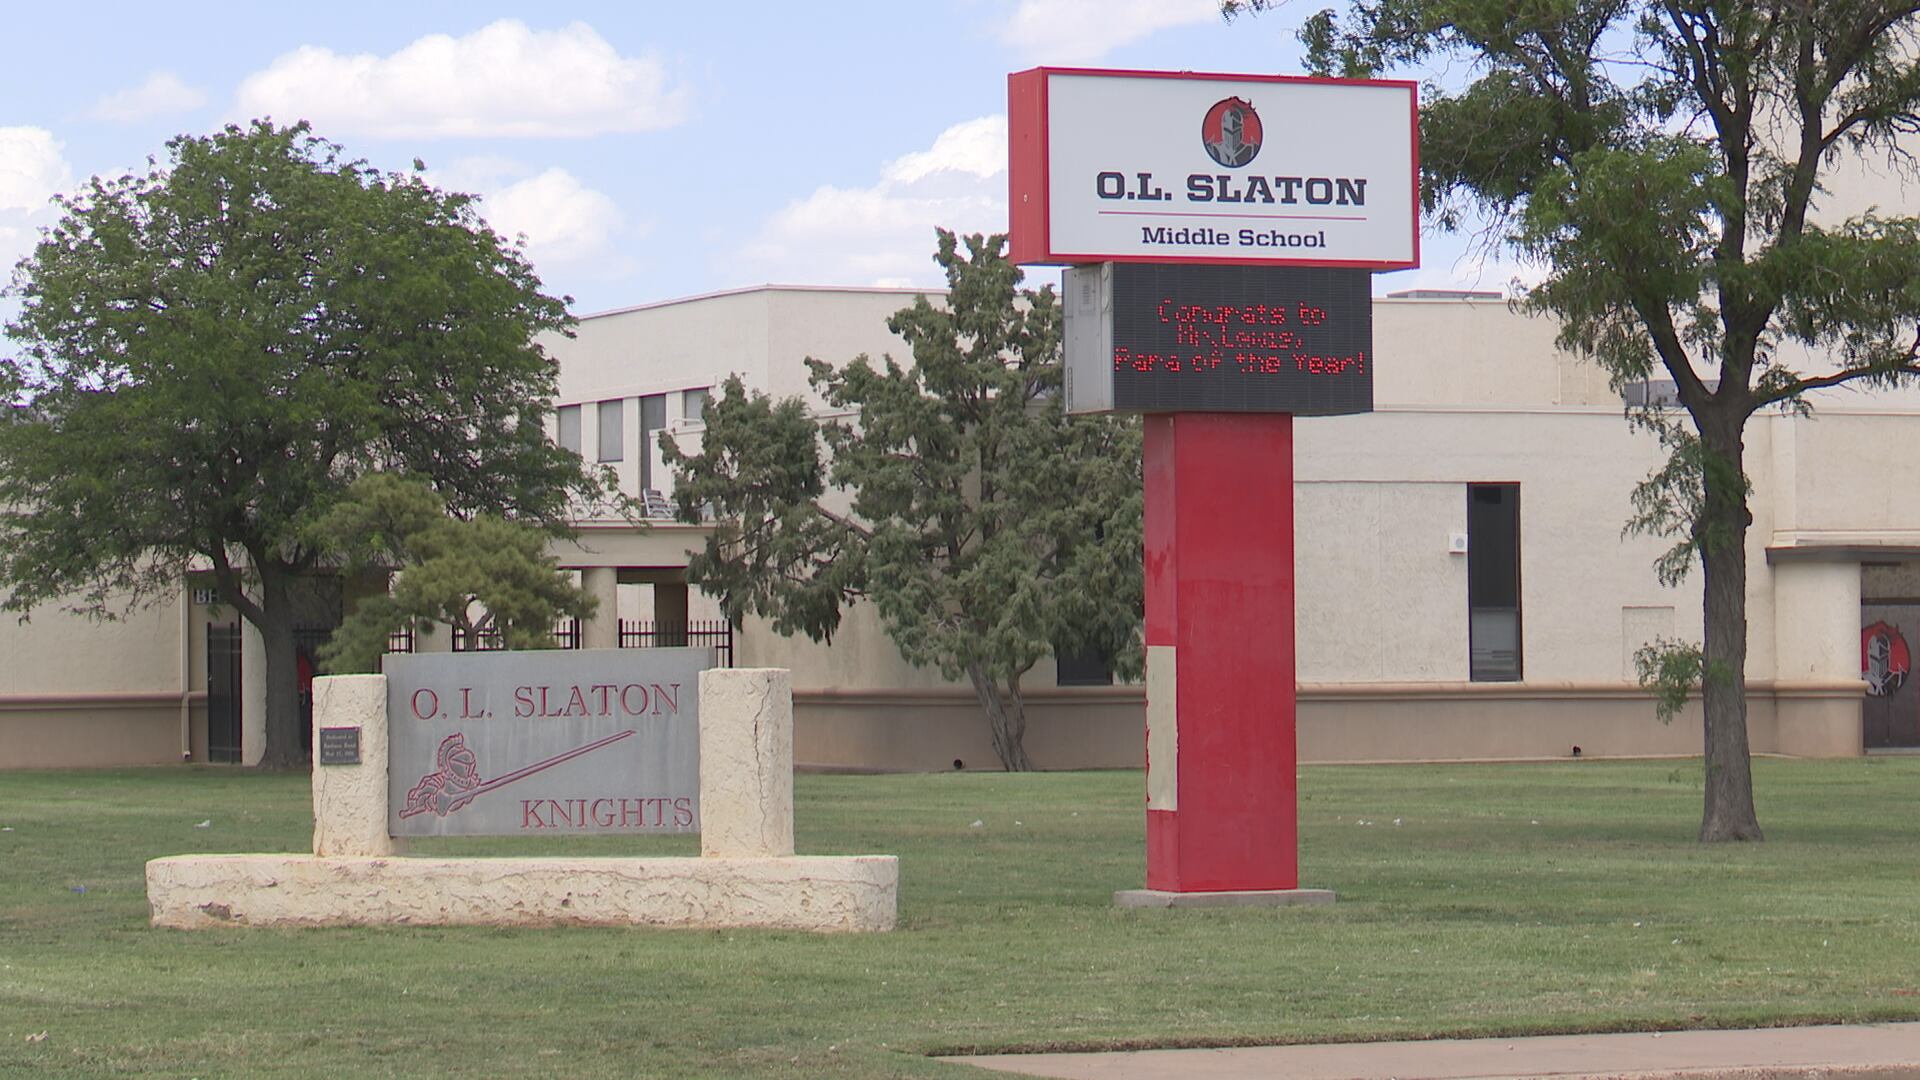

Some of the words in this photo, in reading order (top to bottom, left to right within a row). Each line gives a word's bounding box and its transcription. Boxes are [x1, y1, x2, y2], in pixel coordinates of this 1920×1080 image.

[1096, 171, 1173, 201] O.L.
[1186, 173, 1367, 206] SLATON
[1141, 226, 1230, 246] Middle
[1238, 229, 1326, 248] School
[1298, 302, 1326, 325] to
[1114, 347, 1181, 372] Para
[1191, 350, 1223, 373] of
[1235, 352, 1281, 374] the
[1293, 352, 1365, 375] Year!
[410, 687, 448, 720] O.
[460, 686, 494, 719] L.
[514, 683, 681, 718] SLATON
[520, 796, 694, 829] KNIGHTS
